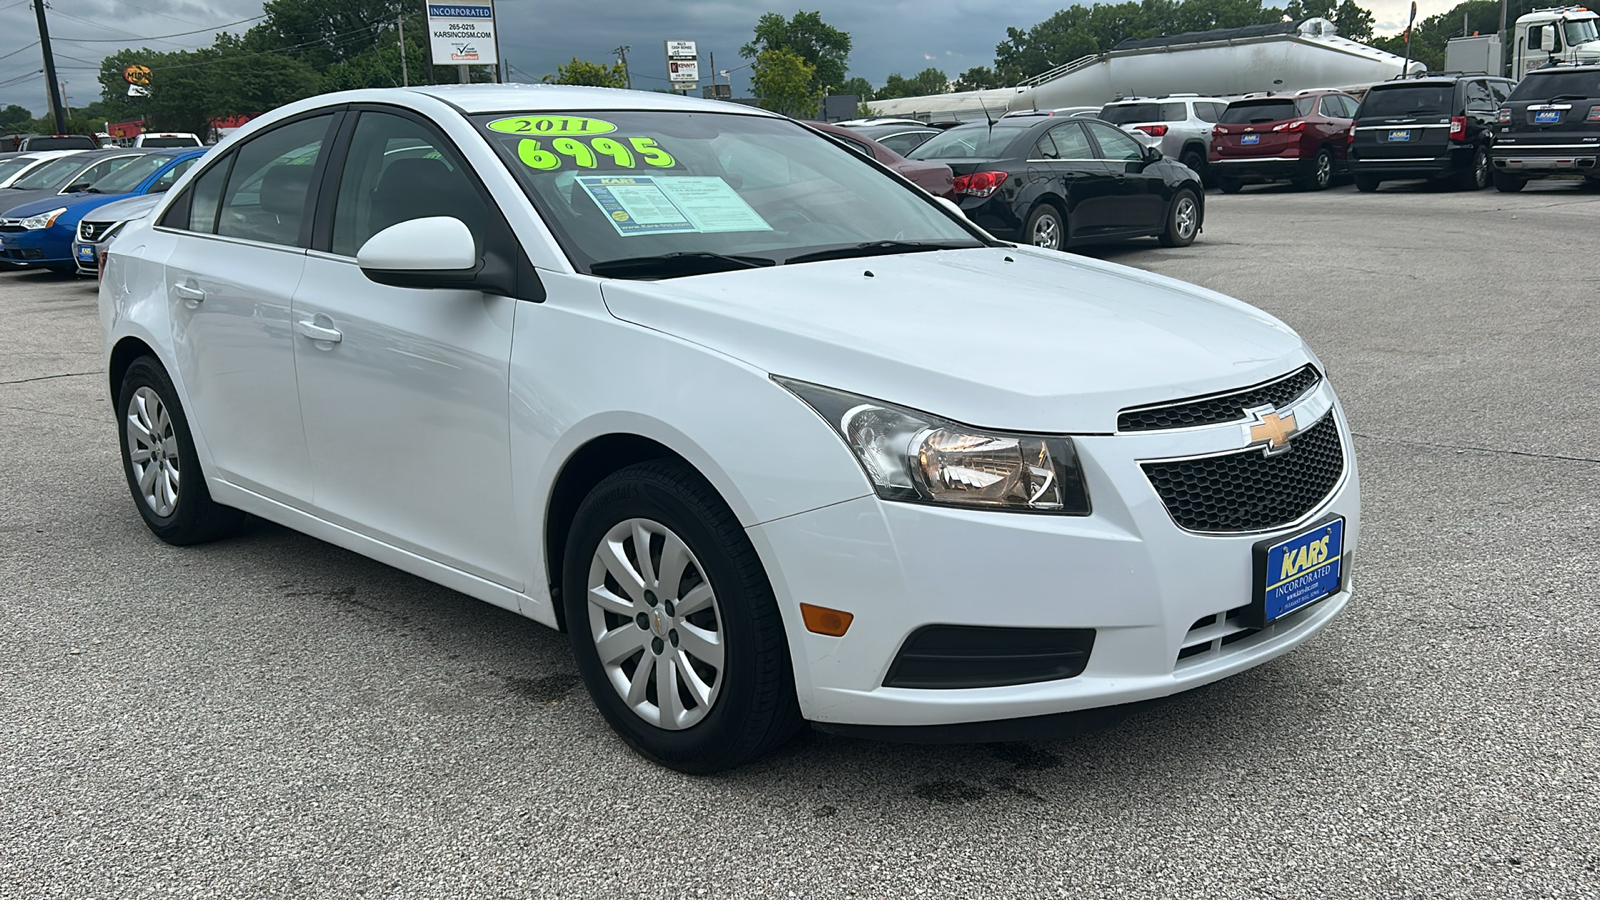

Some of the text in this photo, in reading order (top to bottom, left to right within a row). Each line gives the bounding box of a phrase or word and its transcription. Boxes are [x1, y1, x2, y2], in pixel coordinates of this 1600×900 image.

[430, 8, 490, 16] INCORPORATED
[515, 119, 591, 132] 2011
[518, 137, 676, 170] 6995
[1280, 535, 1330, 580] KARS
[1275, 564, 1331, 598] INCORPORATED
